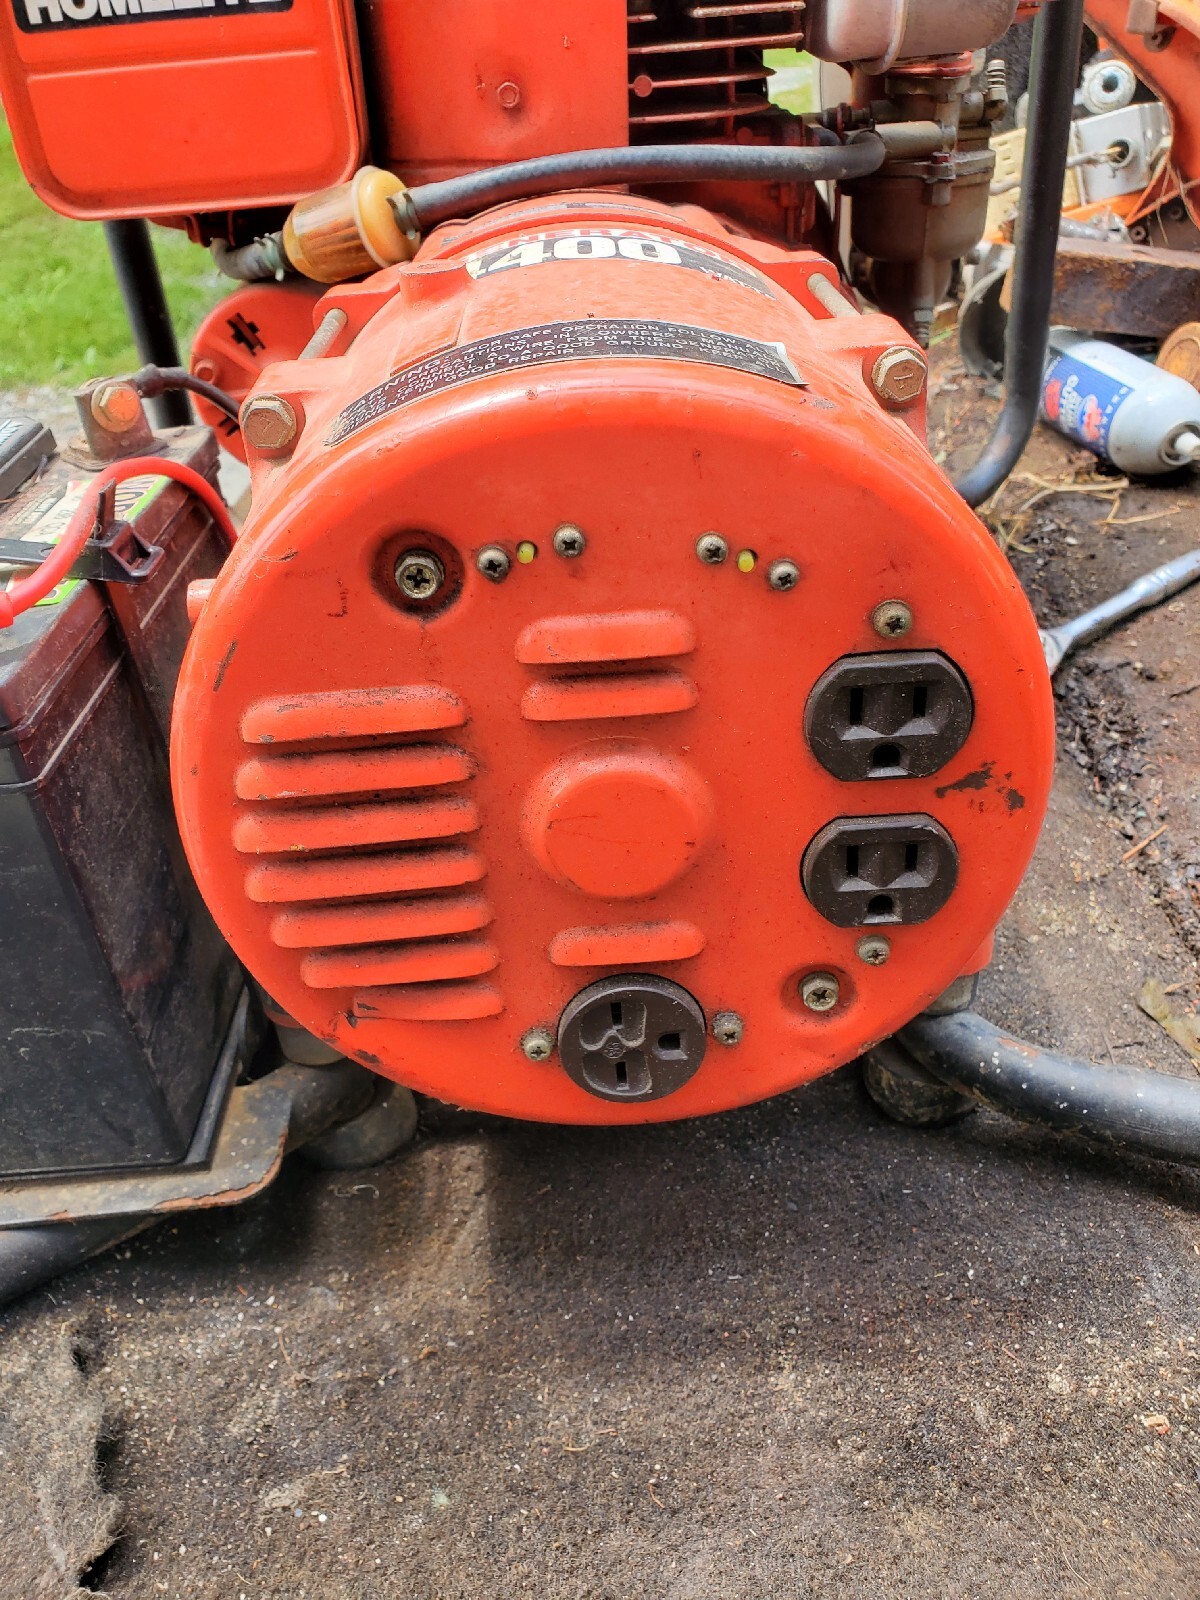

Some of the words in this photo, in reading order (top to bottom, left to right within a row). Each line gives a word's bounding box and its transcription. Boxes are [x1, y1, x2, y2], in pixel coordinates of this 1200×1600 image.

[474, 229, 756, 278] NERATOR
[510, 329, 551, 341] SAFE
[668, 327, 736, 344] FOLLOW
[510, 340, 554, 352] WIRE
[488, 354, 510, 363] TO
[542, 341, 595, 351] GOOD
[418, 383, 433, 392] IN
[445, 363, 496, 381] GOOD
